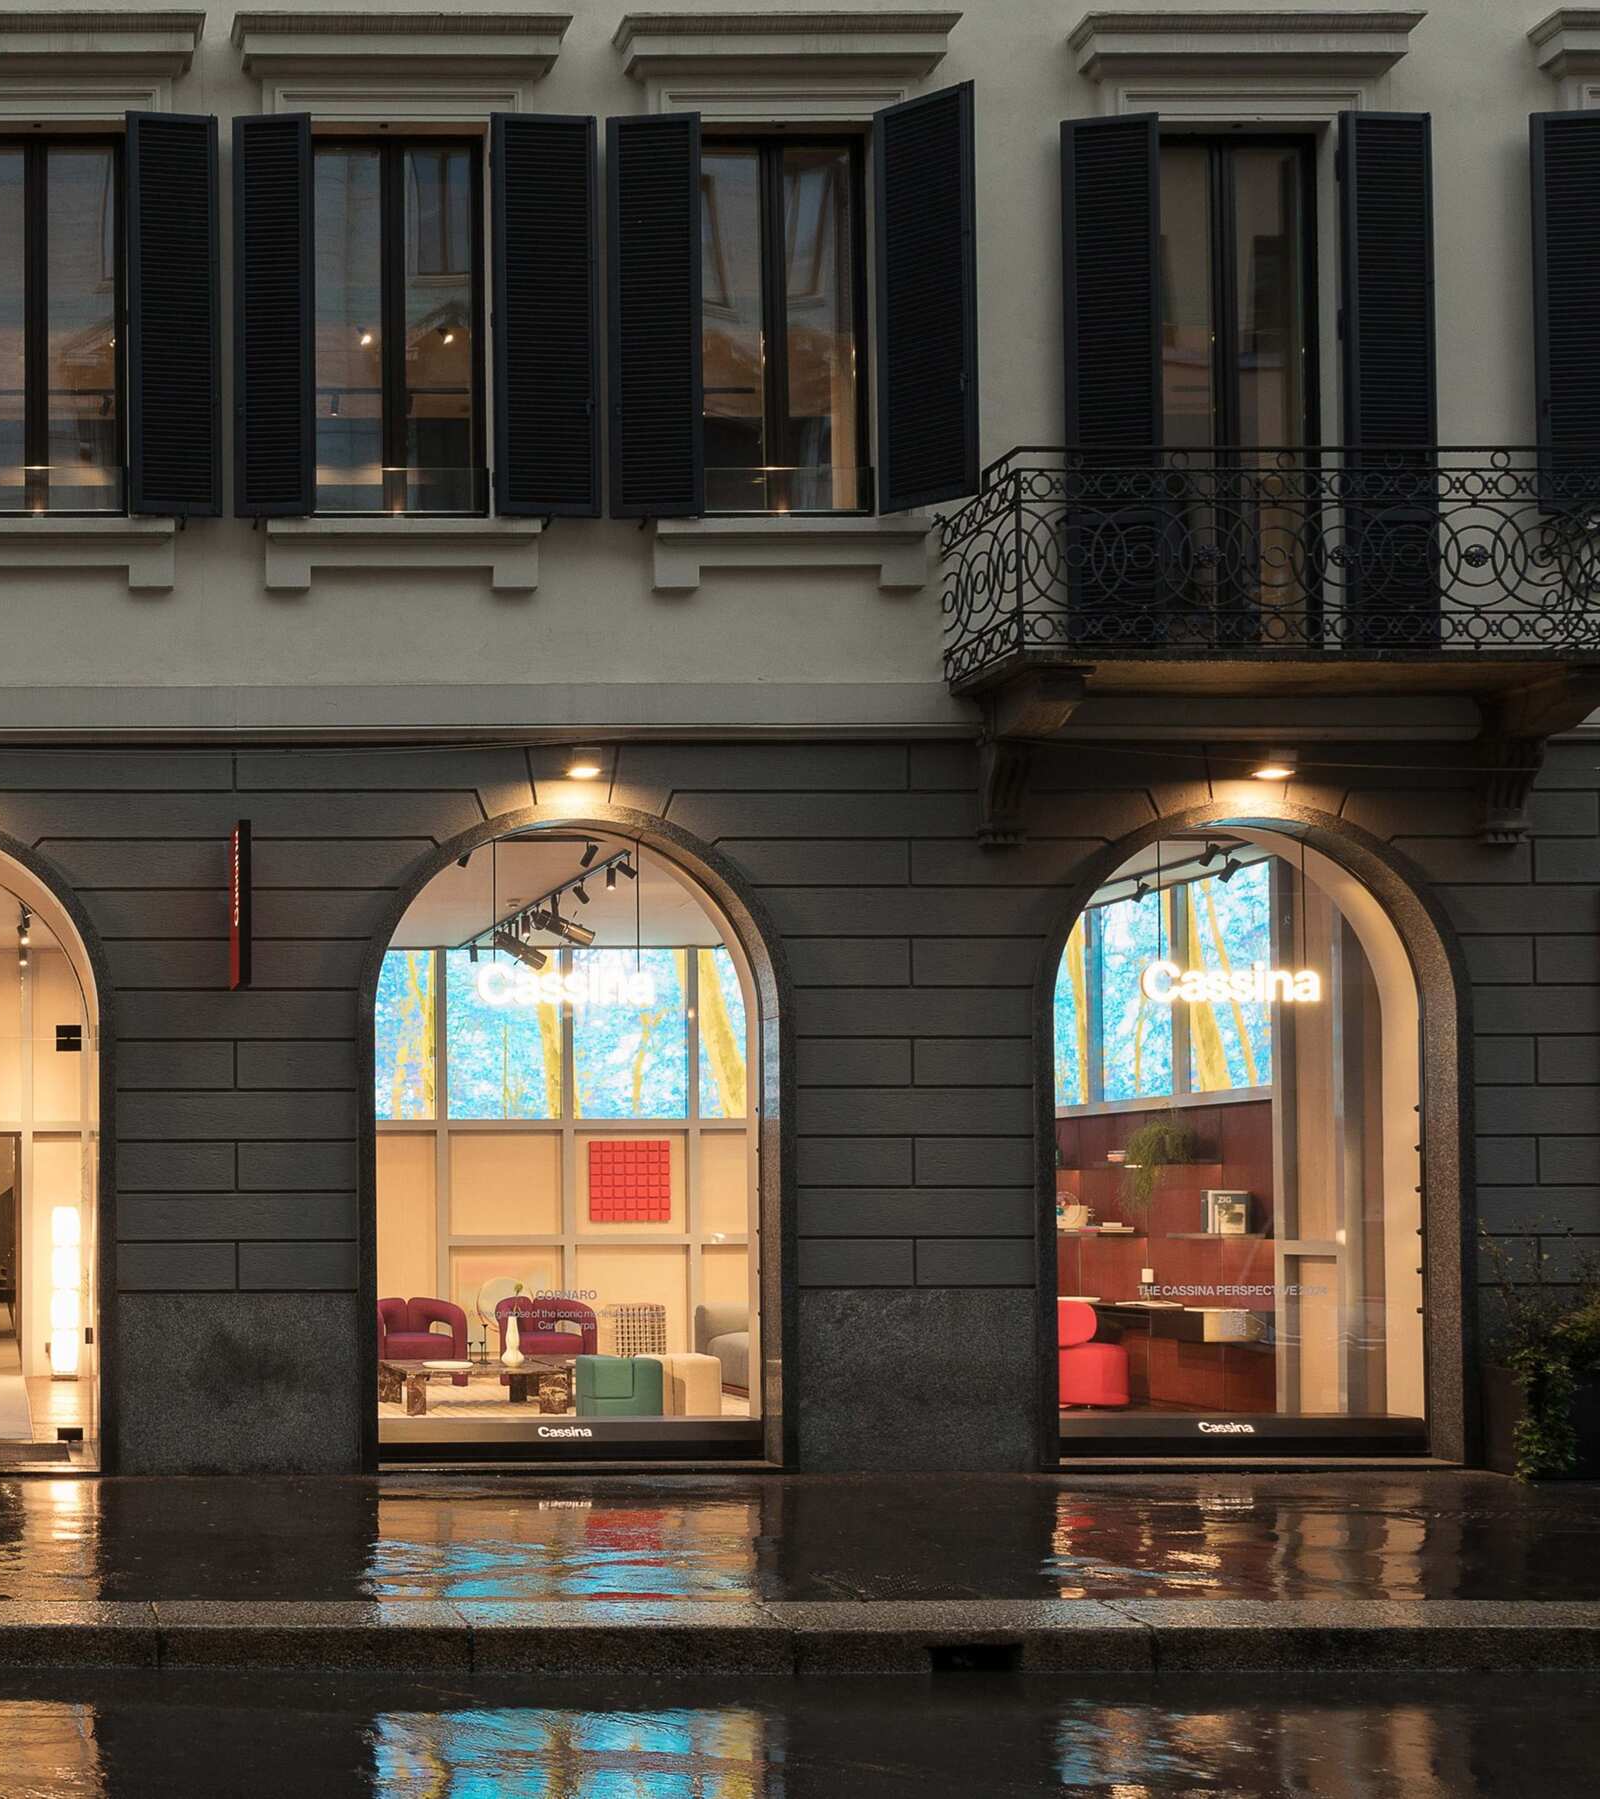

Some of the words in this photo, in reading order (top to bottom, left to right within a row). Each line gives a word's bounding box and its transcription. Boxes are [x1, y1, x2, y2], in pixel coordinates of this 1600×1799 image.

[477, 963, 656, 1006] Cassina
[1141, 960, 1320, 1002] Cassina
[535, 1290, 597, 1300] CORNARO
[1137, 1285, 1161, 1296] THE
[1162, 1285, 1215, 1297] CASSINA
[1216, 1285, 1297, 1297] PERSPECTIVE
[531, 1309, 541, 1318] of
[541, 1309, 556, 1318] the
[557, 1309, 583, 1318] iconic
[538, 1320, 558, 1330] Carl
[538, 1426, 592, 1438] Cassina
[1198, 1421, 1255, 1433] Cassina
